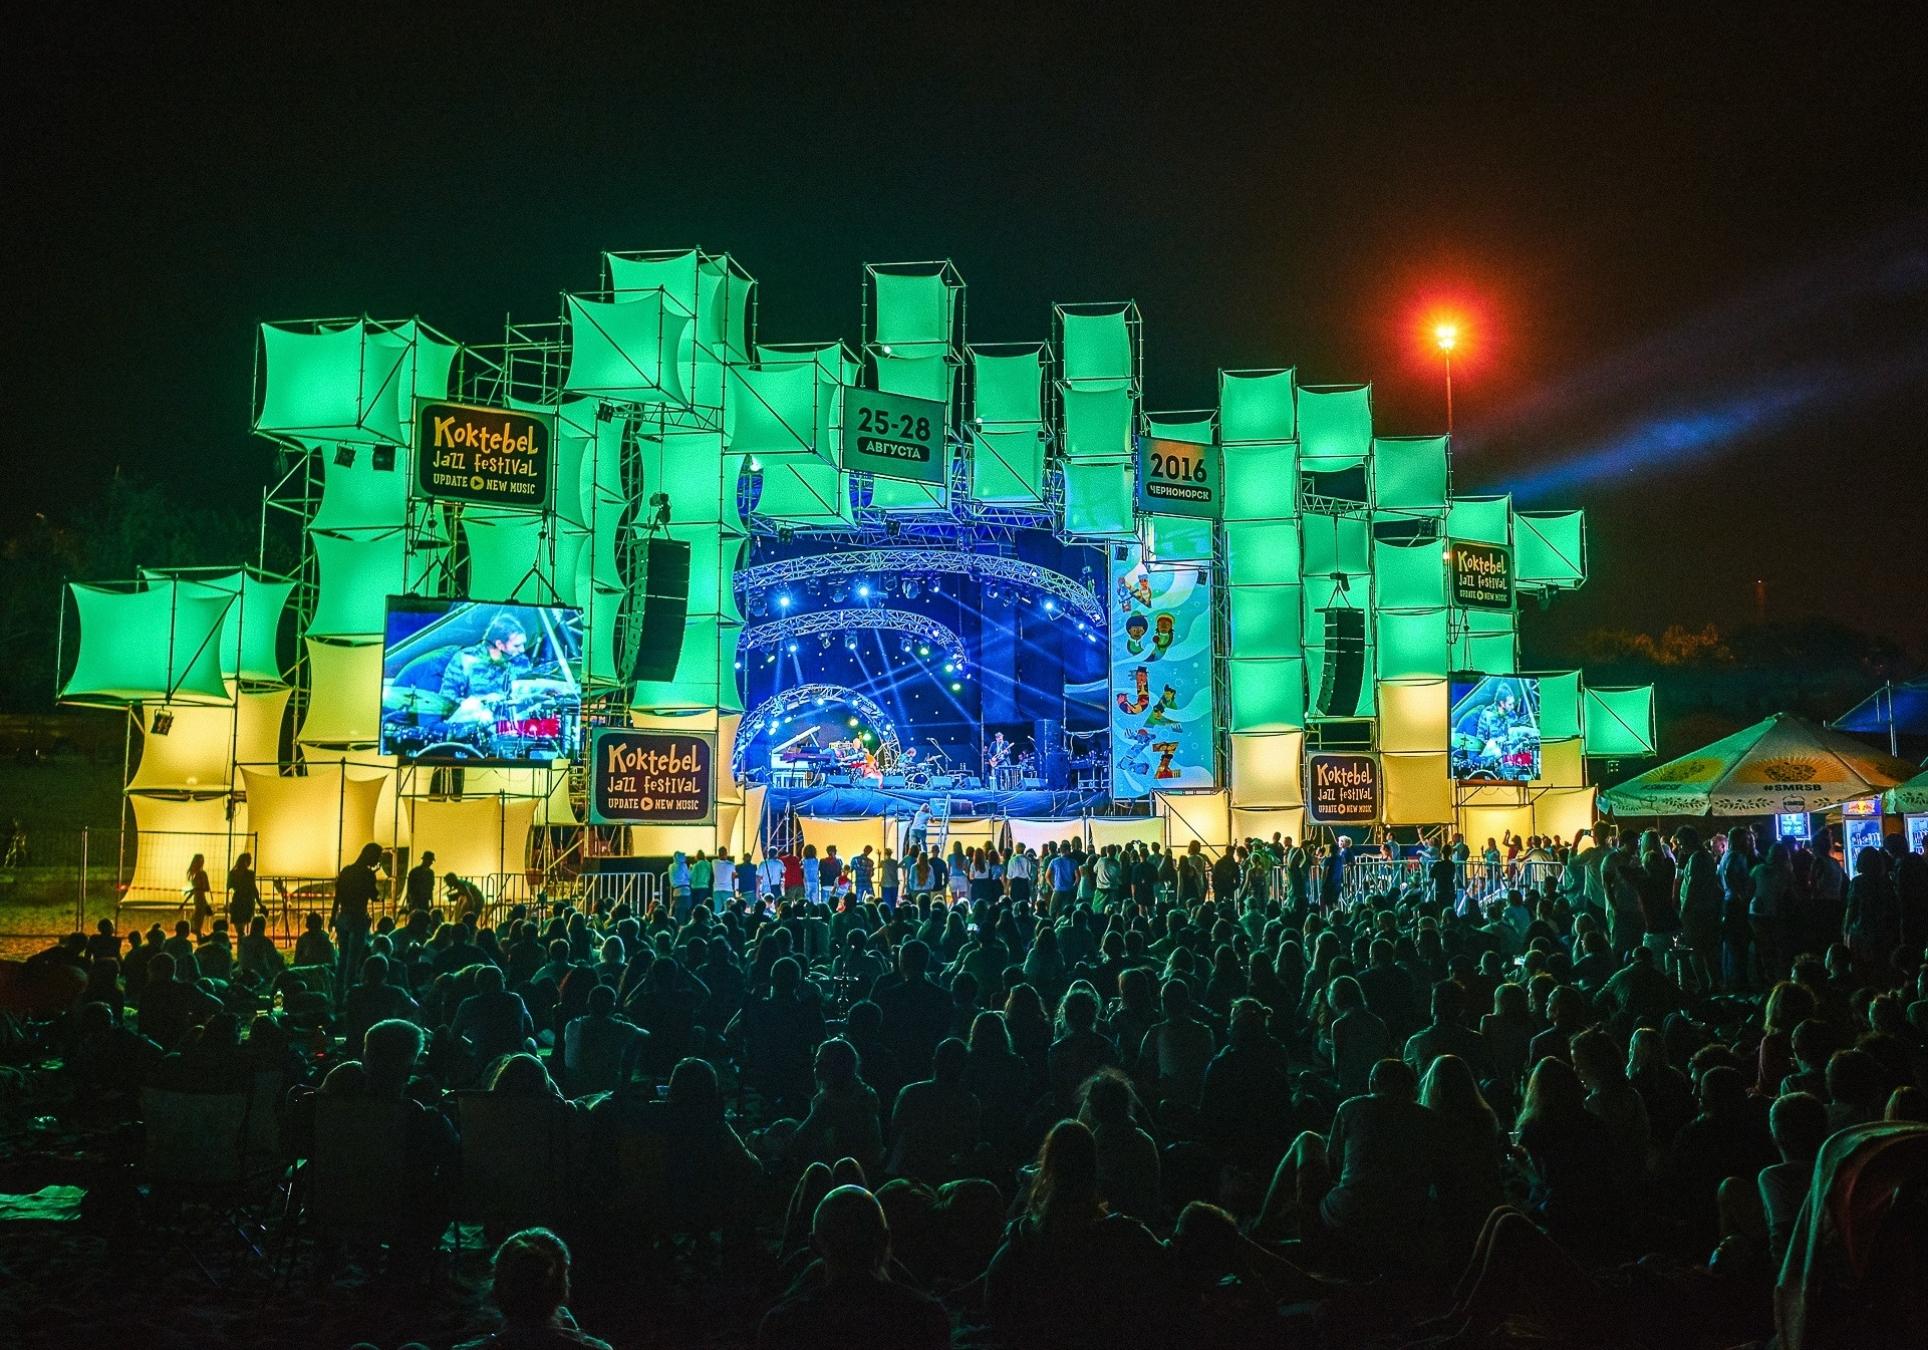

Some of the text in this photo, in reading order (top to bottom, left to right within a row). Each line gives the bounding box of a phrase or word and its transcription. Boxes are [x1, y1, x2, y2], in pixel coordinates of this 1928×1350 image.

[434, 416, 538, 455] Koktebel
[857, 407, 931, 442] 25-28
[866, 440, 921, 459] АВГУСТА
[1150, 453, 1208, 483] 2016
[433, 473, 536, 494] UPDATE NEW MUSIC
[1150, 485, 1209, 500] ЧЕРНОМОРСК
[1457, 550, 1507, 576] Koktebel
[608, 742, 701, 776] Koktebel
[1317, 762, 1373, 788] Koktebel
[608, 798, 699, 811] UPDATE NEW MUSIC
